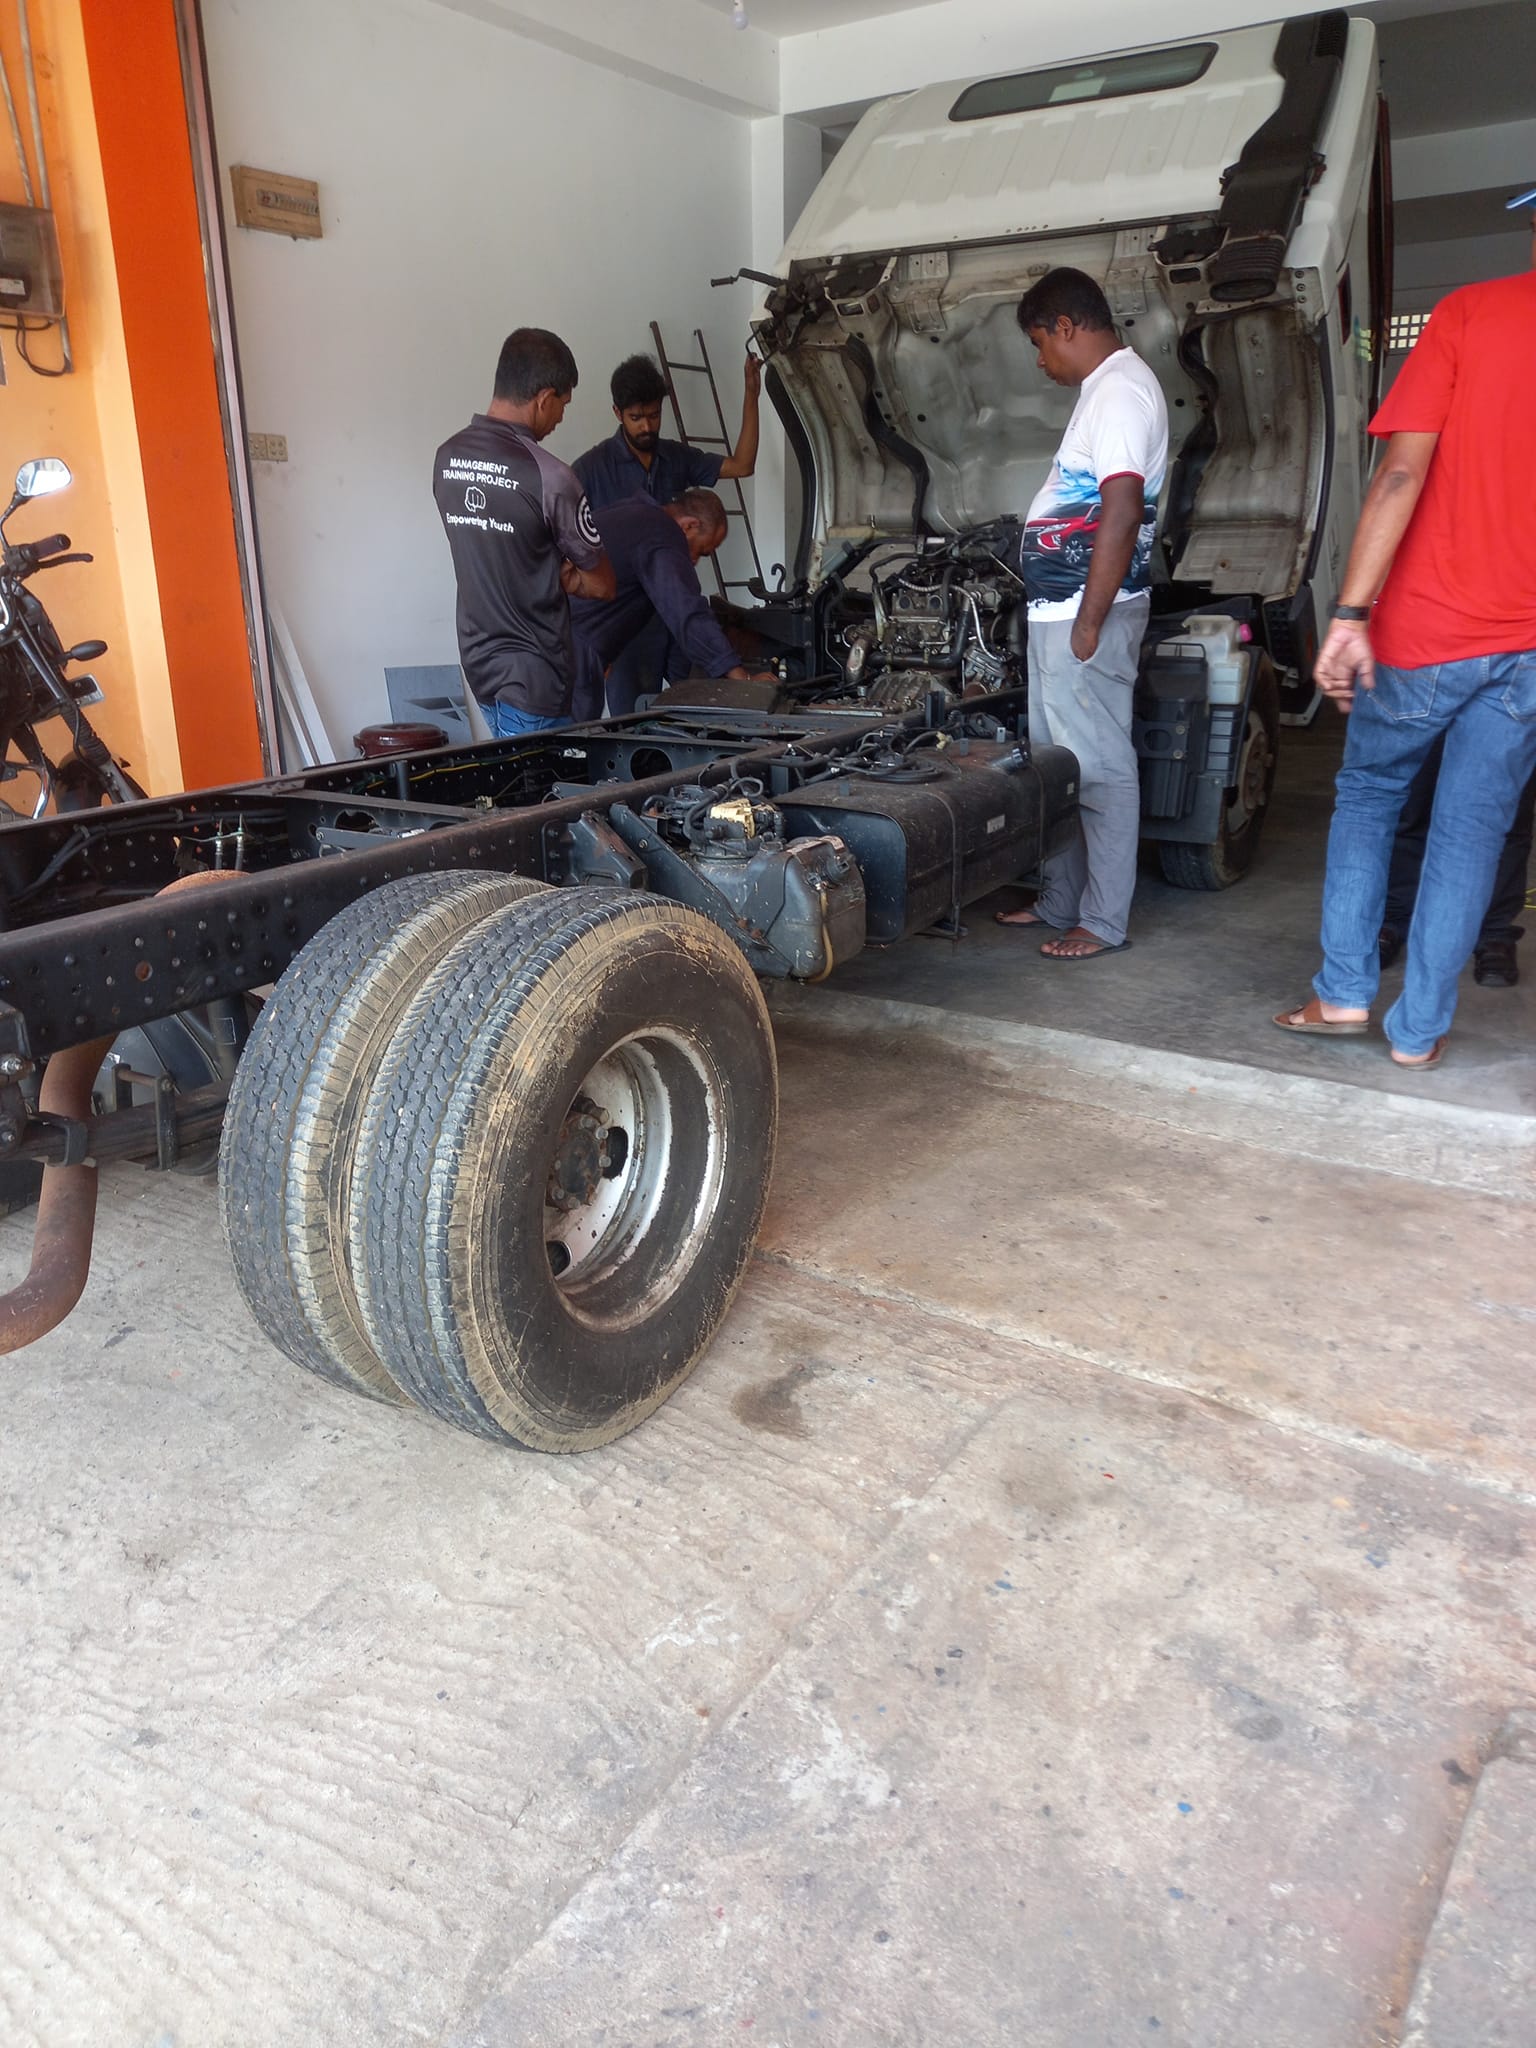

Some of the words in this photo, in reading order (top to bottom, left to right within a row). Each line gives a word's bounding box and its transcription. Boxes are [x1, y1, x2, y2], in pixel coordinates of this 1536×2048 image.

[449, 457, 509, 475] MANAGEMENT
[442, 469, 475, 482] TRAINING
[476, 472, 519, 491] PROJECT
[446, 512, 488, 531] Empowering
[488, 516, 514, 534] Youth
